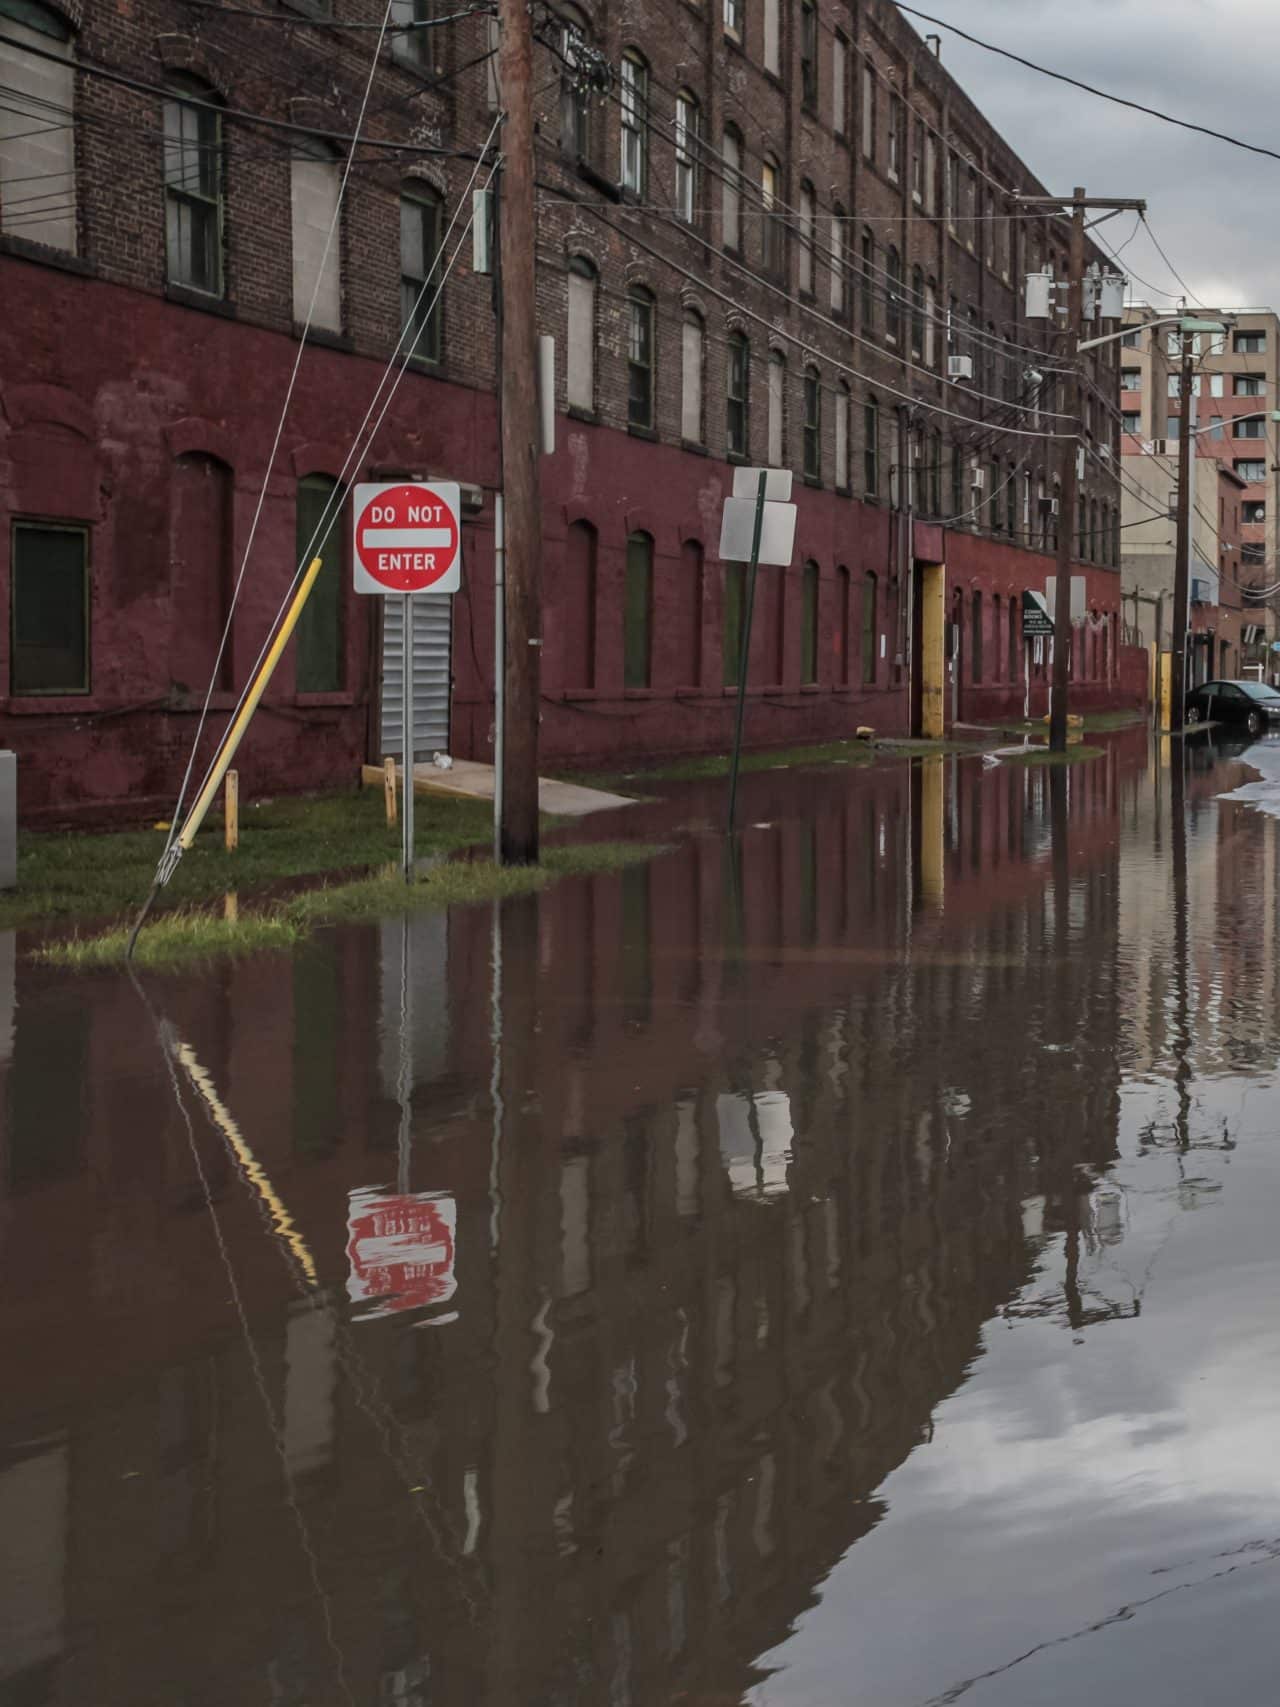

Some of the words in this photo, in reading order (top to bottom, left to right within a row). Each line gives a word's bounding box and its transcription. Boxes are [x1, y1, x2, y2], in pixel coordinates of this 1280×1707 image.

[371, 506, 395, 523] DO
[408, 506, 443, 523] NOT
[378, 553, 436, 570] ENTER
